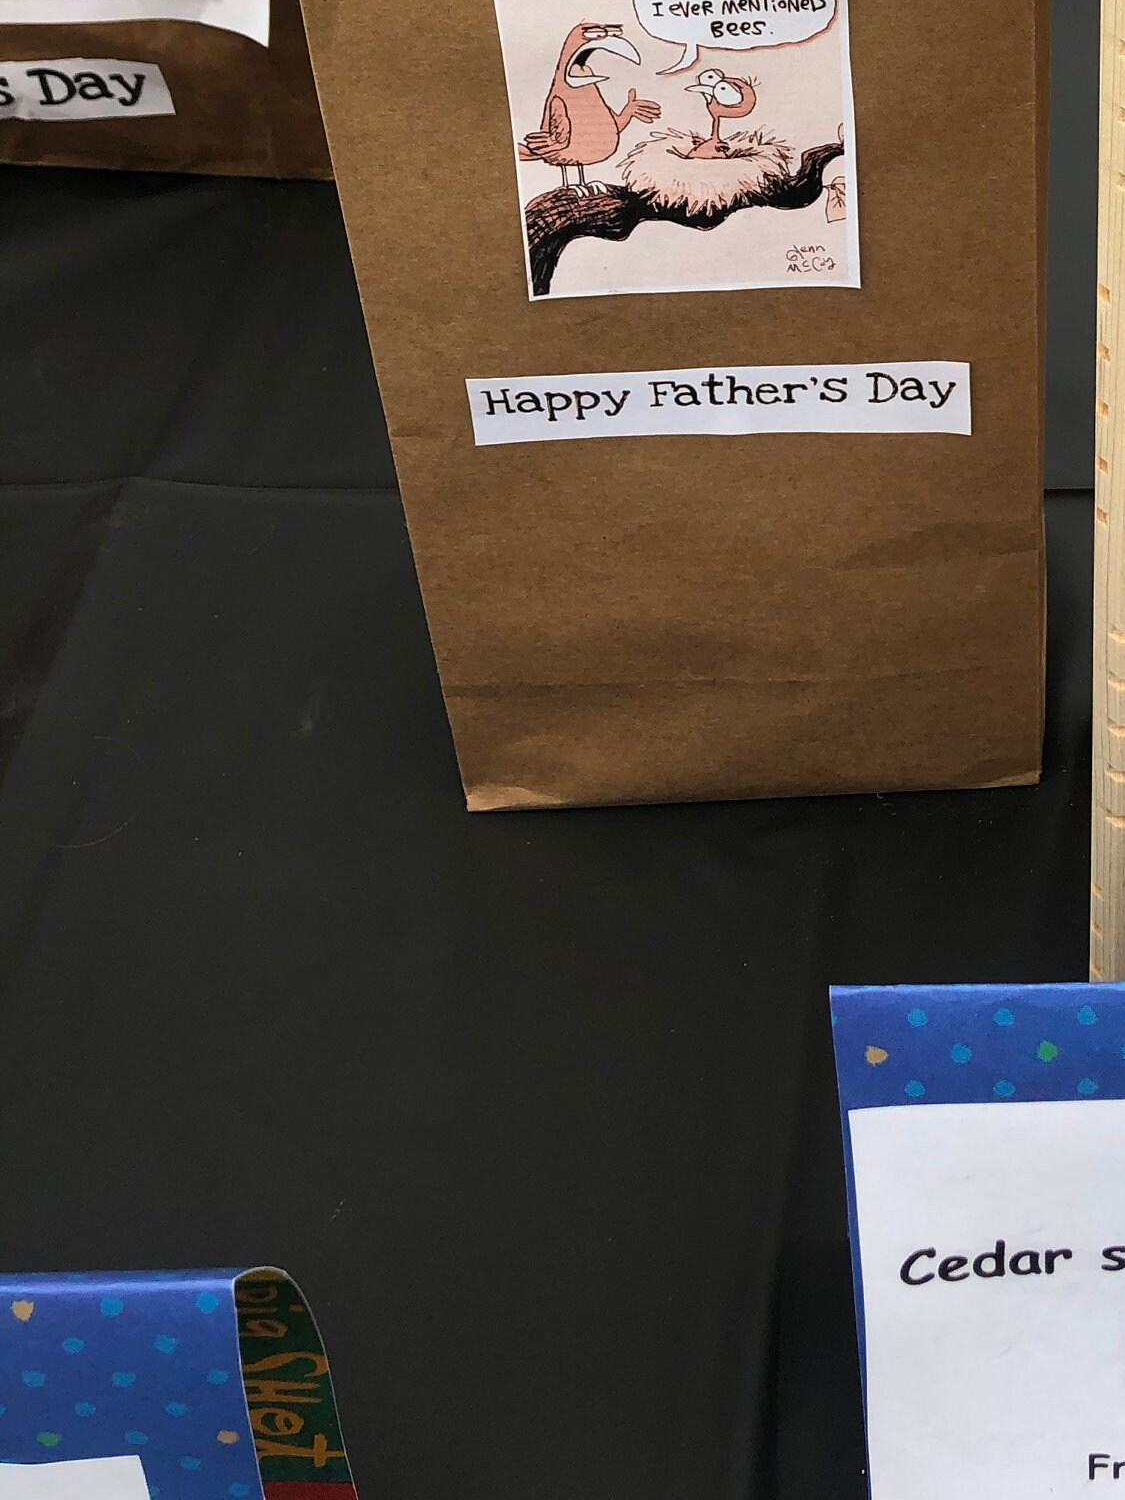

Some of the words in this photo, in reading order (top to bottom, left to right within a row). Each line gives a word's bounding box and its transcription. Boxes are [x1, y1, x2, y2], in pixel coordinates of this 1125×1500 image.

[652, 2, 664, 17] I
[26, 68, 147, 107] Day
[480, 388, 630, 422] Happy
[647, 373, 848, 407] Father's
[866, 372, 957, 409] Day
[899, 1240, 1073, 1286] Cedar
